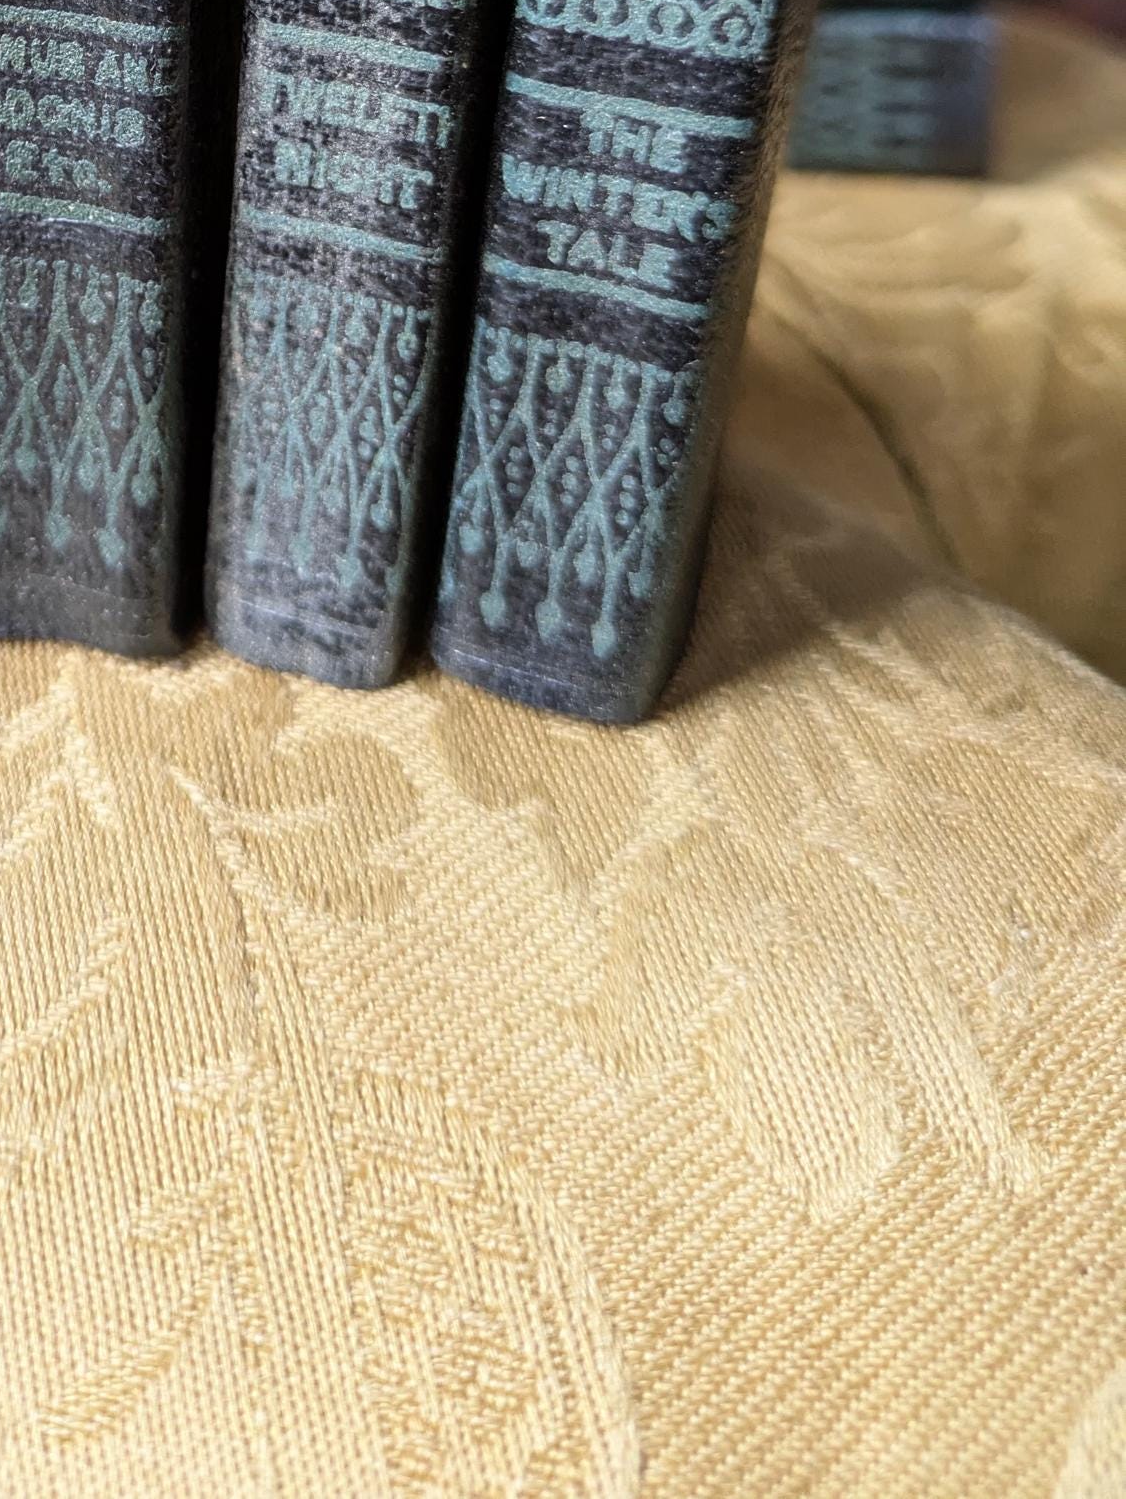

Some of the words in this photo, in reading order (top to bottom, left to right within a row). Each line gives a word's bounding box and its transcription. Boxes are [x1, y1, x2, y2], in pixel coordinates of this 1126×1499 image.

[274, 138, 435, 210] NIGHT
[578, 106, 689, 174] THE
[537, 219, 677, 290] TALE
